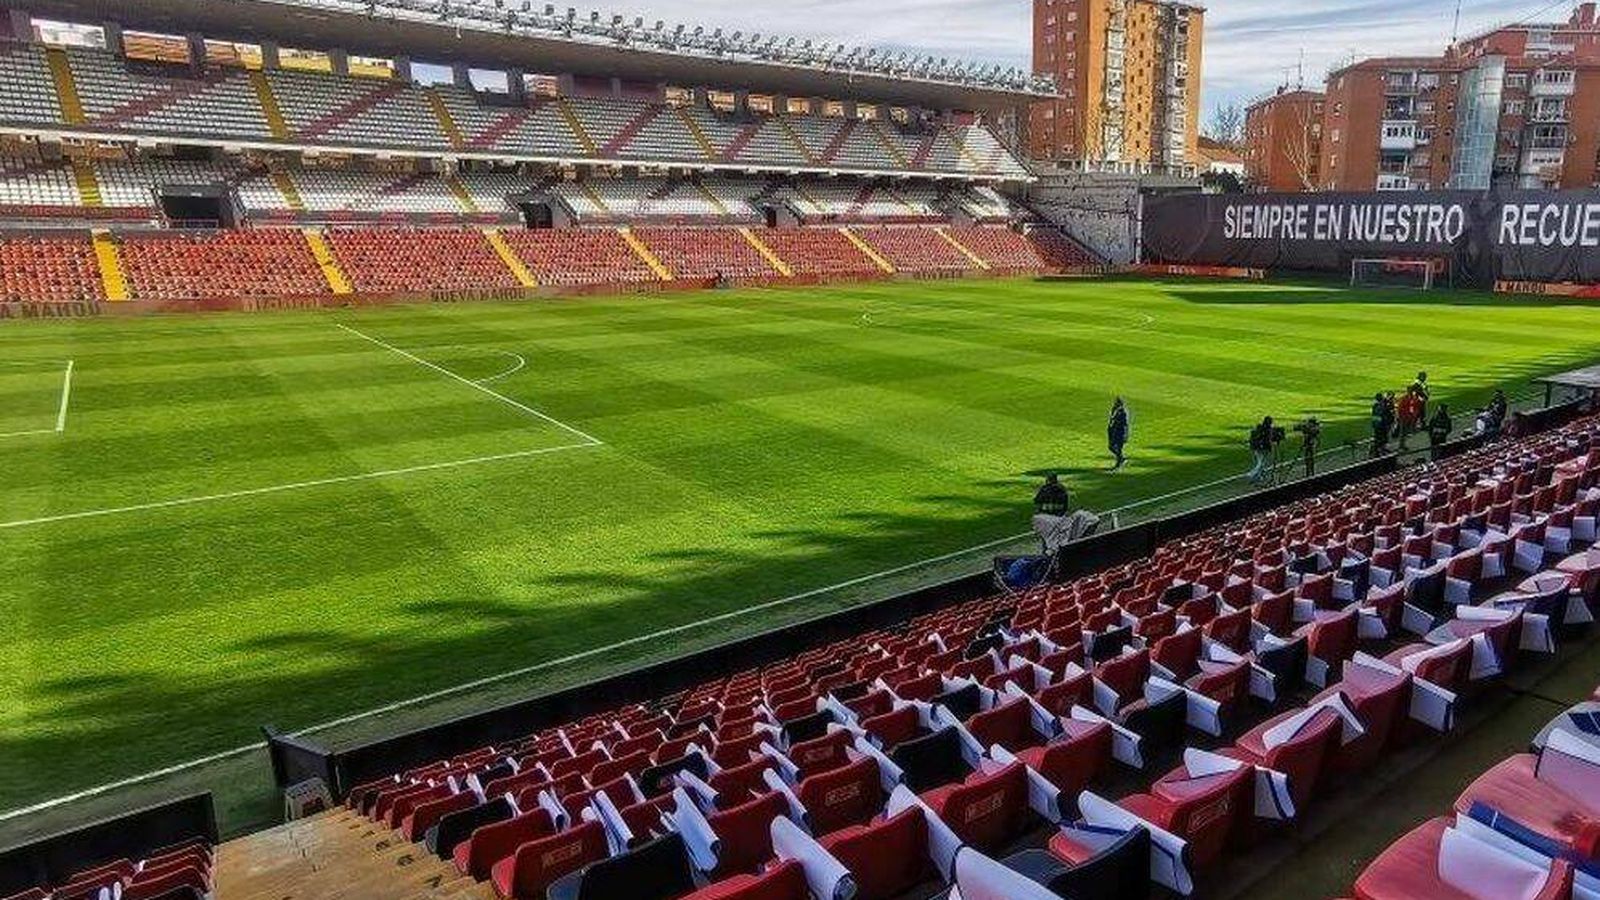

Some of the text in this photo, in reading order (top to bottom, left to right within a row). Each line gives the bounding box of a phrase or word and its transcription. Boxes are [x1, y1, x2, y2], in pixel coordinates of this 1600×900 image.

[1224, 203, 1600, 246] SIEMPRE EN NUESTRO RECUE
